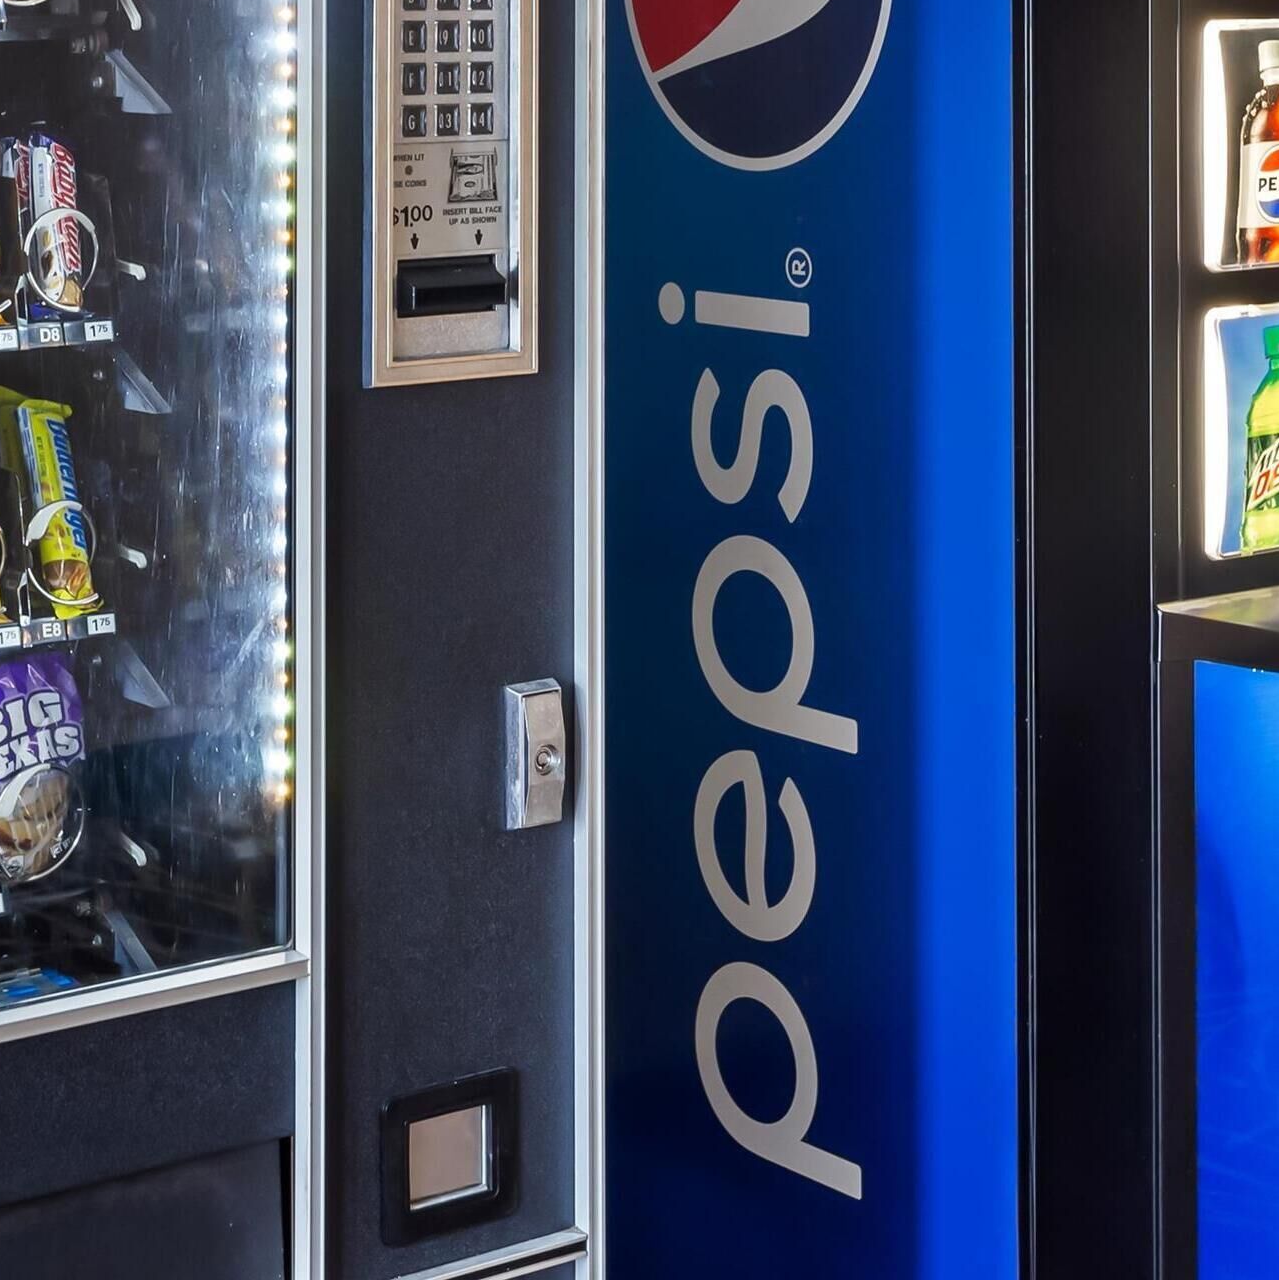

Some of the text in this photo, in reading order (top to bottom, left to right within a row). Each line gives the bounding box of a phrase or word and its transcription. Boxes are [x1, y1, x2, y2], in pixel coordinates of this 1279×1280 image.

[408, 30, 414, 46] E
[408, 72, 414, 88] F
[408, 114, 416, 130] G
[405, 178, 427, 188] COINS
[442, 207, 468, 217] INSERT
[485, 205, 502, 214] FACE
[448, 215, 497, 225] UP AS SHOWN
[40, 328, 61, 342] D8
[42, 622, 61, 638] E8
[657, 281, 863, 1202] pepsi
